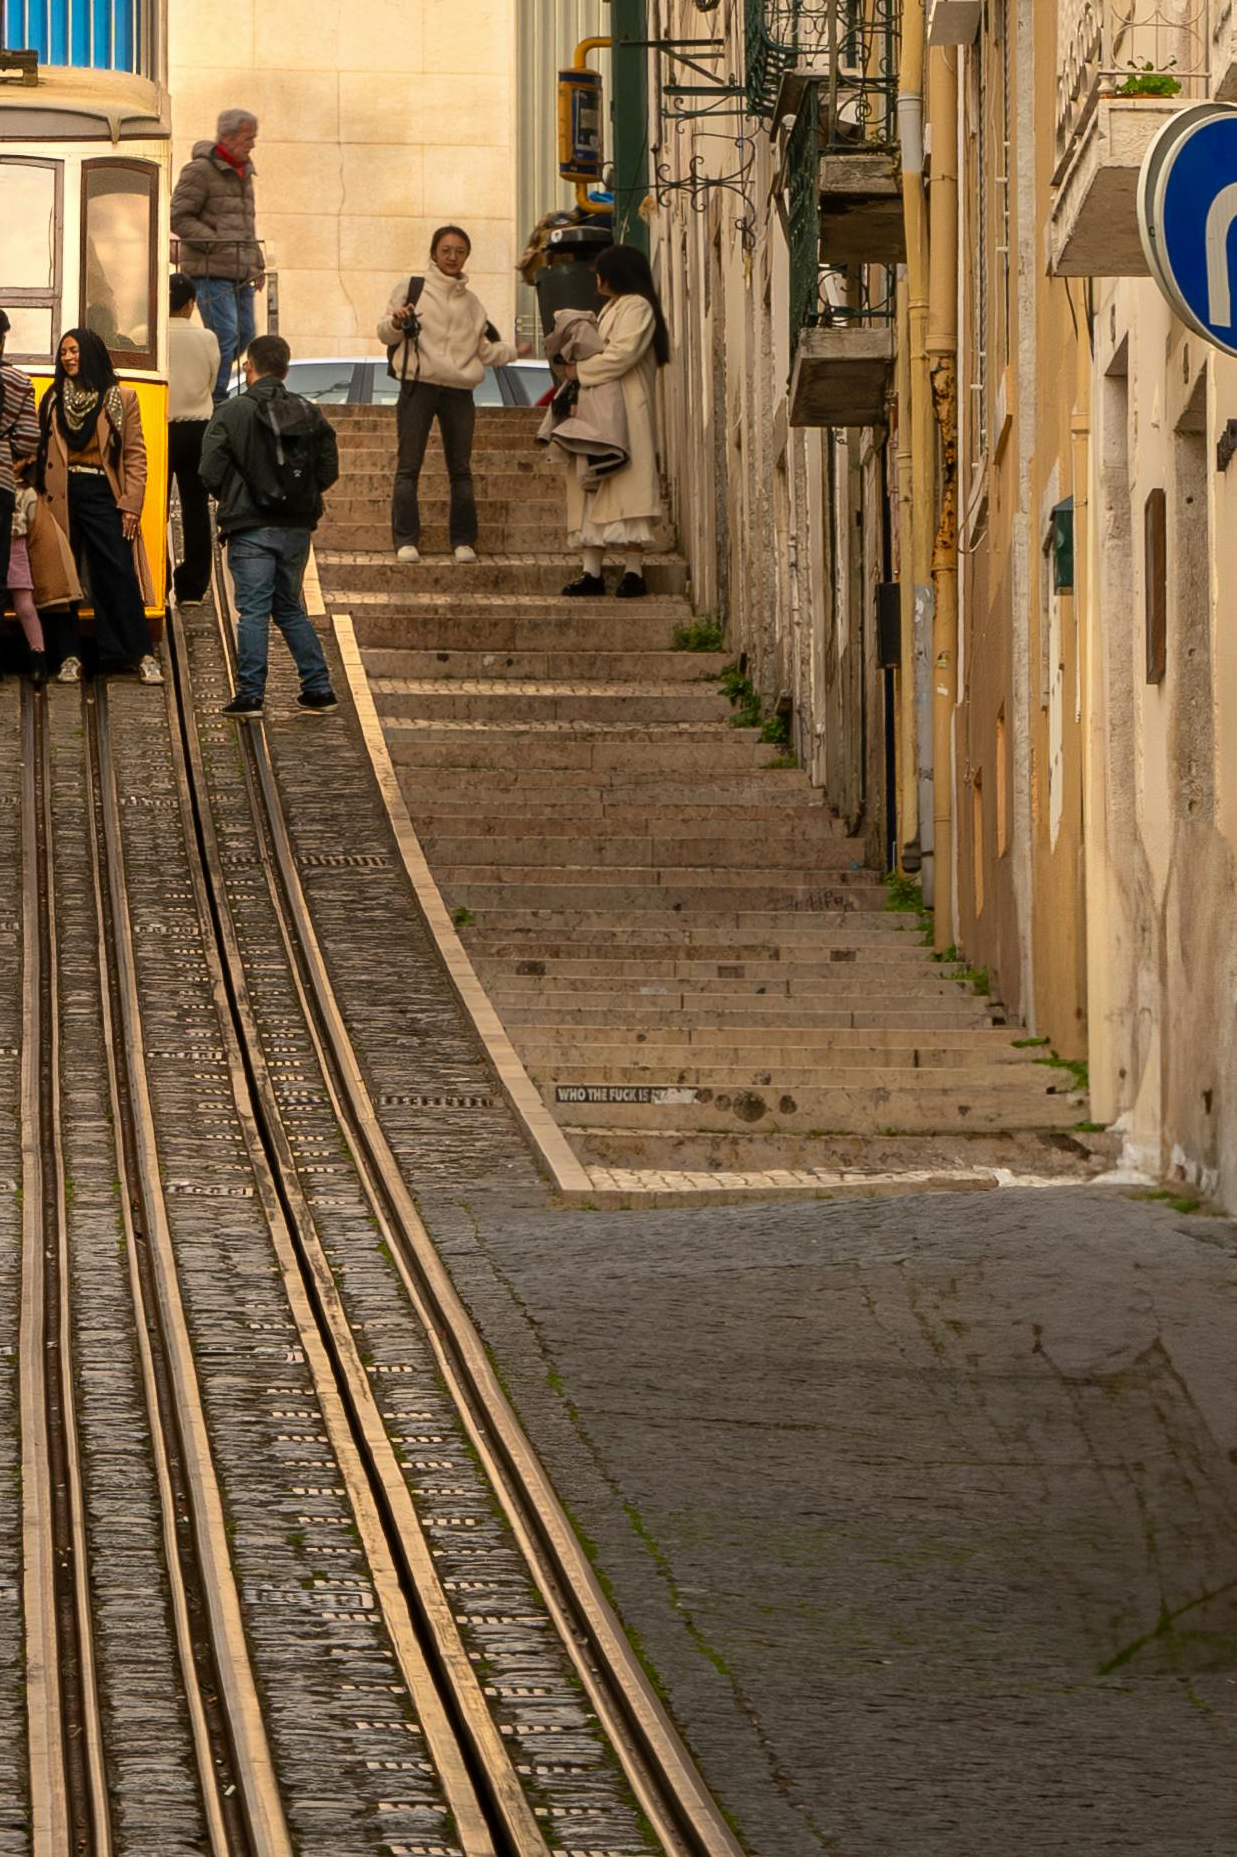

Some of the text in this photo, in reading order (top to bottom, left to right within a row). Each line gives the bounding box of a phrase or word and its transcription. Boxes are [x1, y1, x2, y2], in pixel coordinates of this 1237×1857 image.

[558, 1088, 586, 1101] WHO
[587, 1088, 607, 1101] THE
[609, 1088, 637, 1101] FUCK
[639, 1088, 650, 1101] IS
